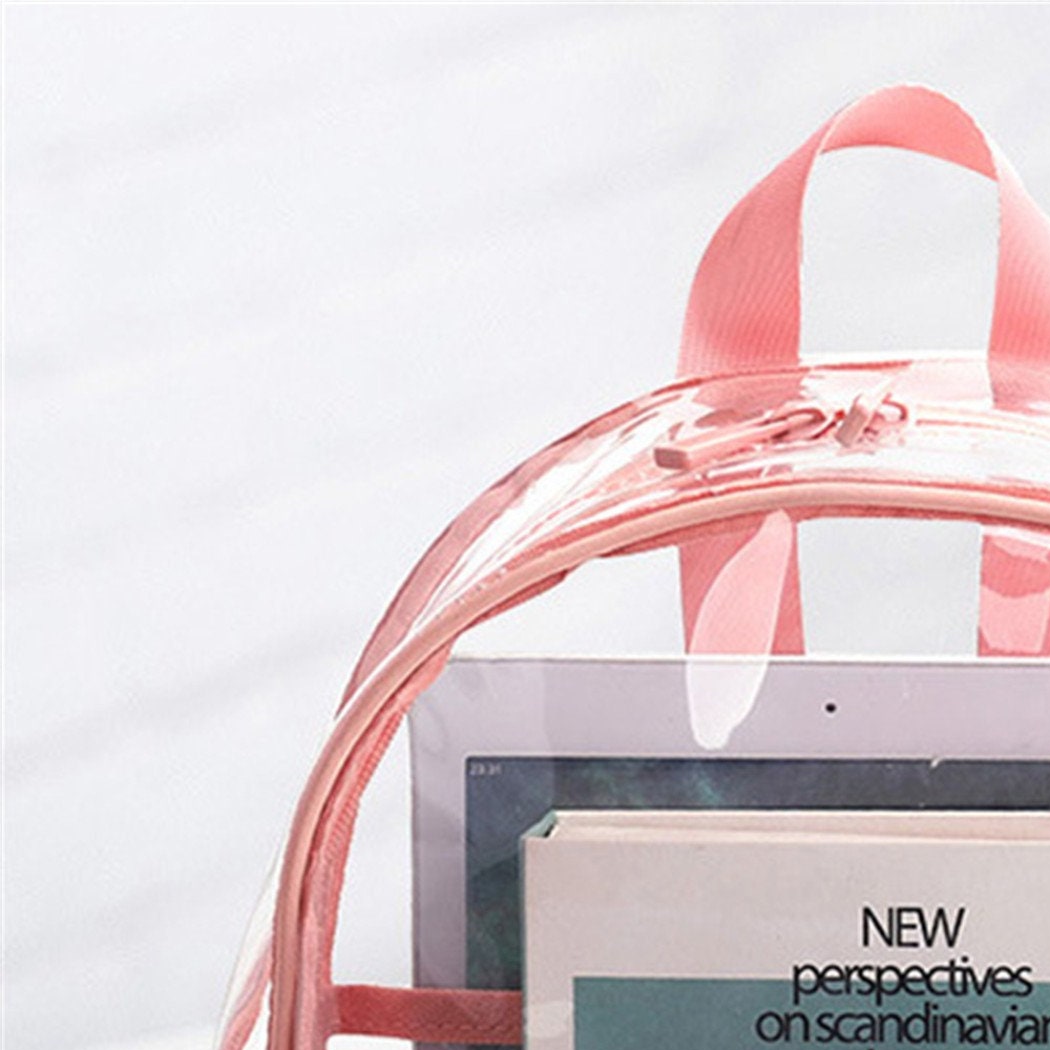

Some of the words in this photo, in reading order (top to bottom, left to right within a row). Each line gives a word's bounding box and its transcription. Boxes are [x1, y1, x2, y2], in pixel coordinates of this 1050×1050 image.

[862, 906, 966, 948] NEW
[792, 956, 1033, 1006] perspectives
[755, 1010, 810, 1044] on
